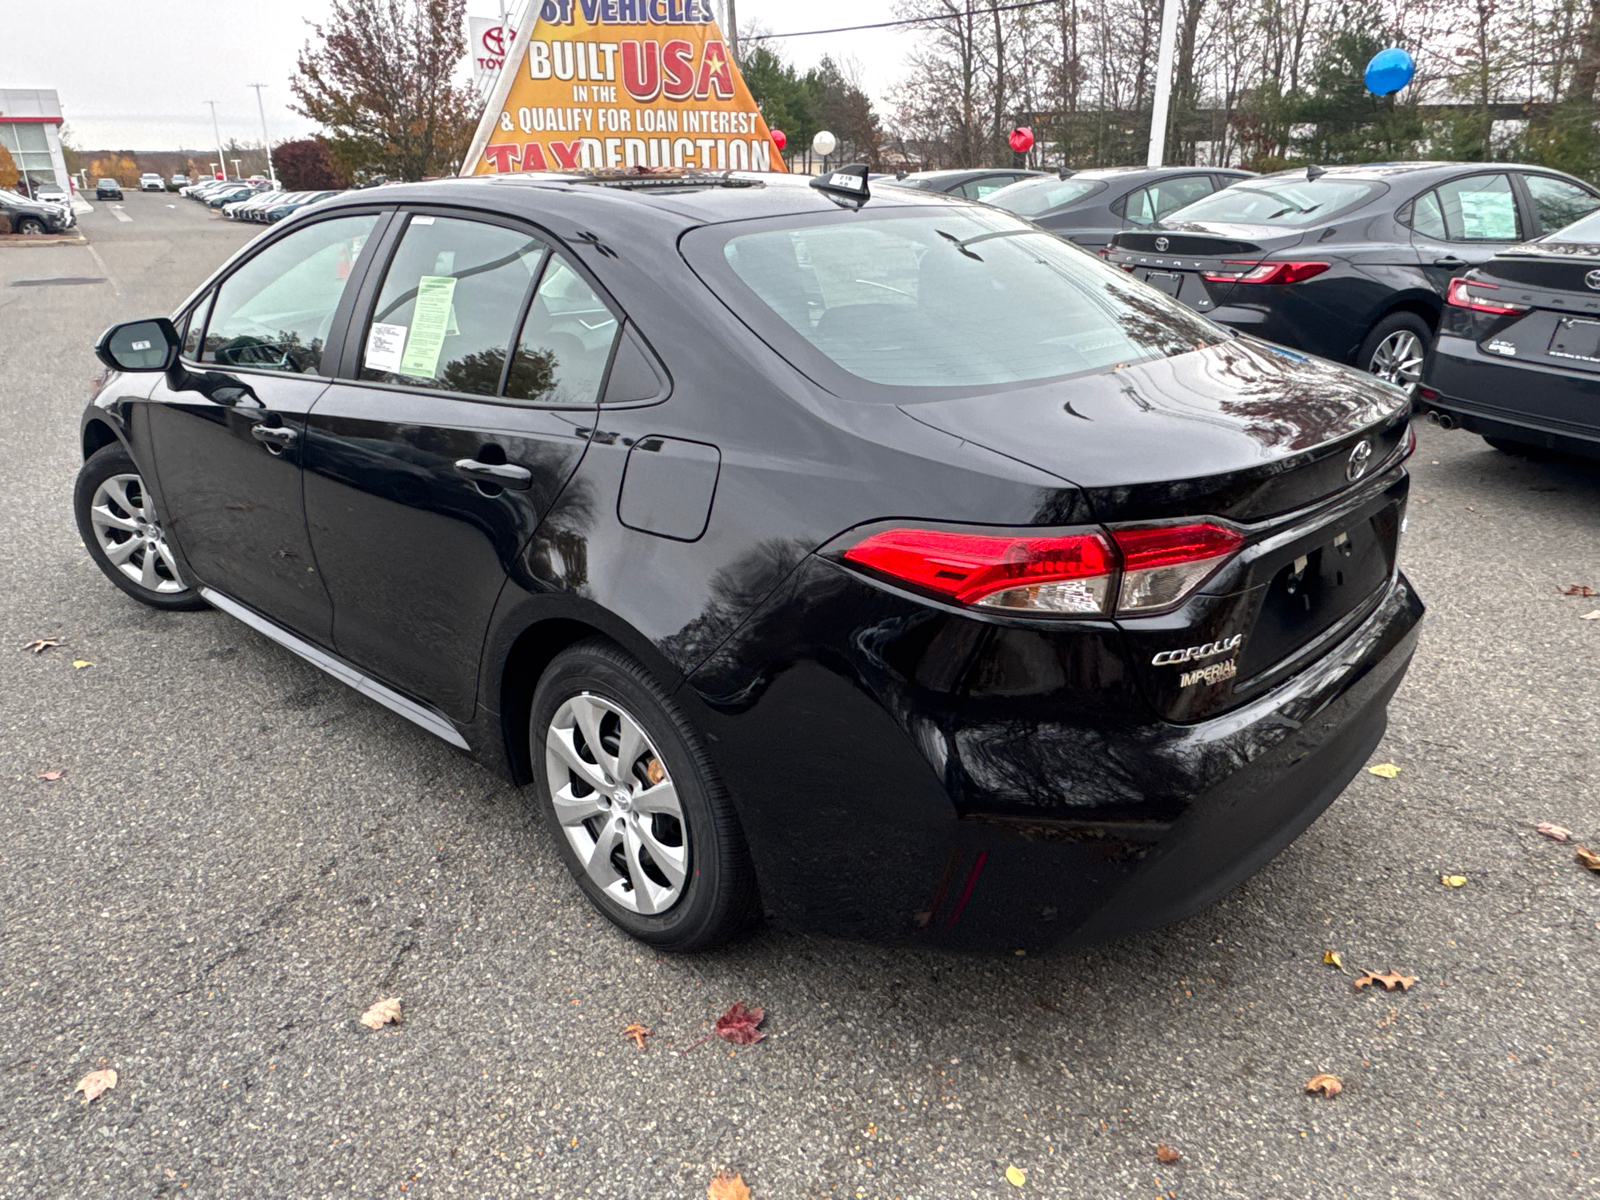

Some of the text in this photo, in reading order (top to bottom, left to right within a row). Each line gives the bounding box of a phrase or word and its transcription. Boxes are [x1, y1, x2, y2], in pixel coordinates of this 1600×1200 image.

[579, 0, 715, 25] VEHICLES
[528, 39, 736, 102] BUILT USA
[573, 85, 617, 103] IN THE
[500, 107, 758, 134] & QUALIFY FOR LOAN INTEREST
[485, 138, 770, 173] TAX DEDUCTION
[1152, 633, 1242, 666] COROLLA
[1180, 658, 1237, 688] IMPERIAL
